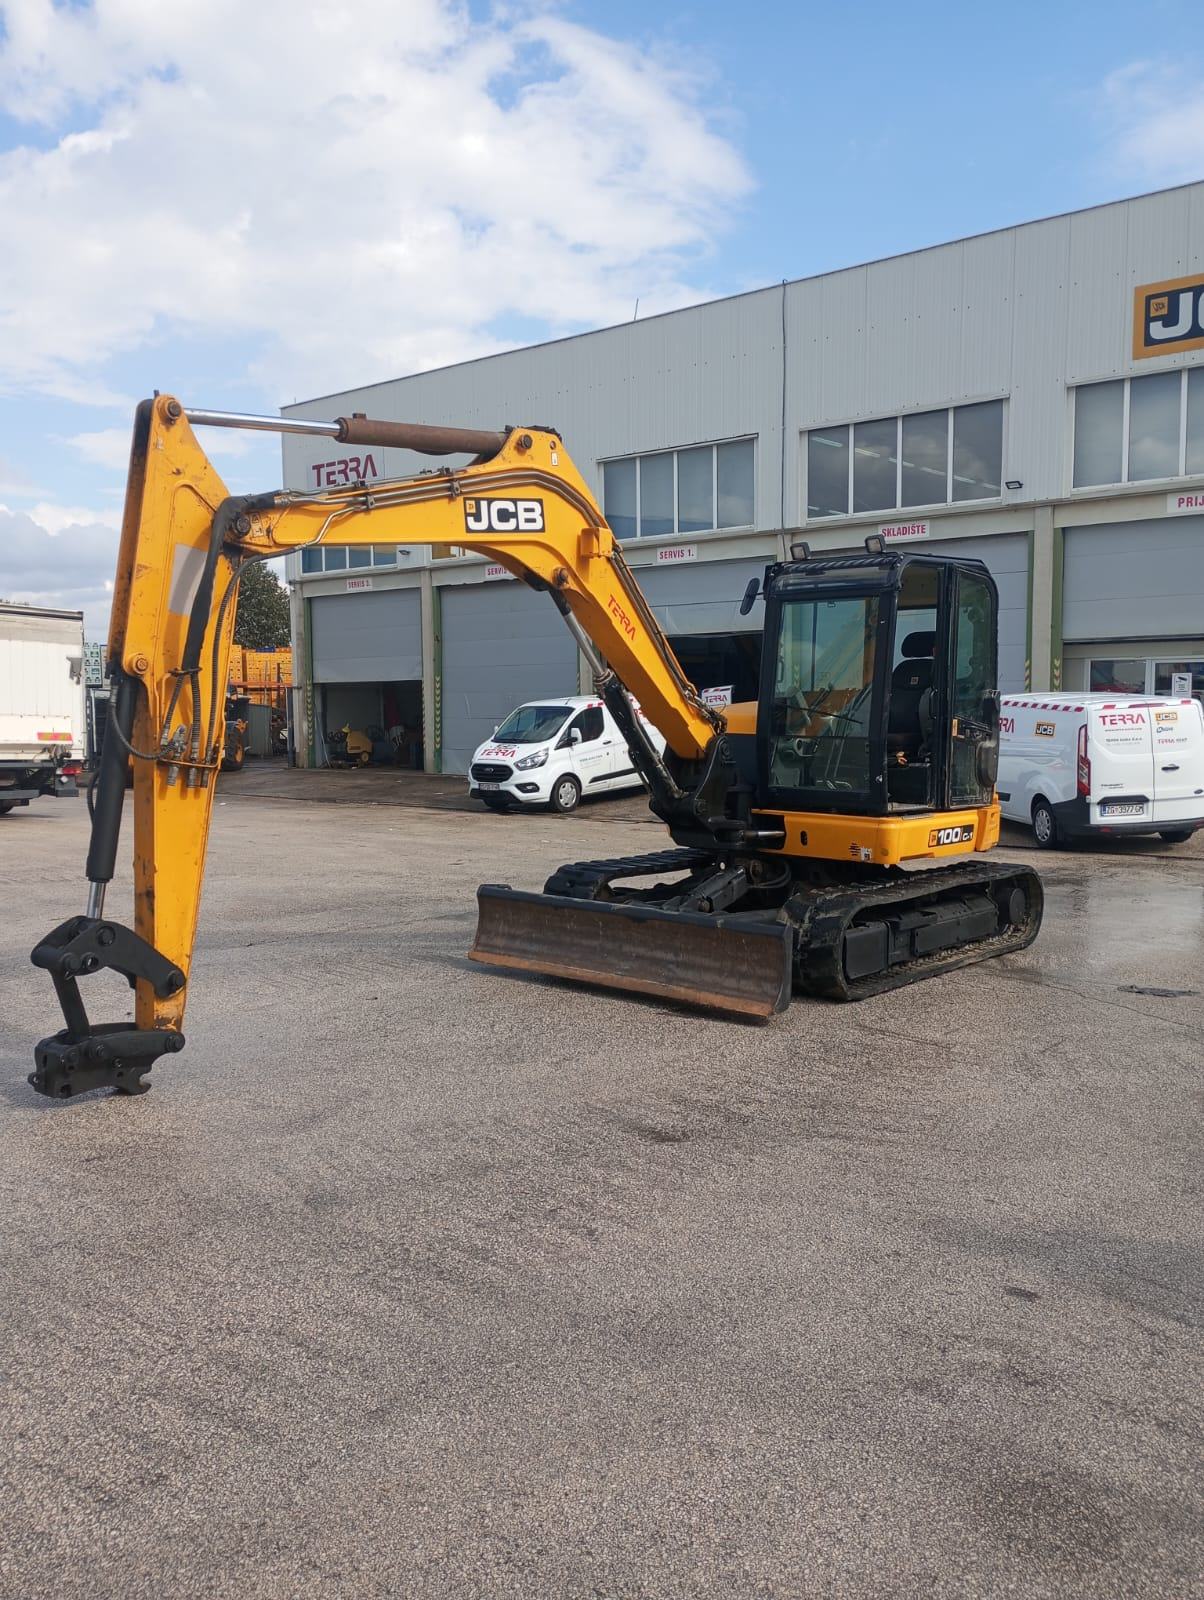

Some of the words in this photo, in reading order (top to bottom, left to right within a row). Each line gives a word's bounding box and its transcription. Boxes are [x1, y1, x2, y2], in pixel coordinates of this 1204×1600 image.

[1149, 291, 1204, 340] J
[312, 454, 377, 487] TERRA
[466, 500, 543, 531] JCB
[881, 522, 926, 538] SKLADIŠTE
[659, 549, 685, 560] SERVIS
[687, 548, 695, 557] 1.
[608, 594, 635, 640] TERRA
[705, 694, 728, 703] TERRA
[1098, 713, 1145, 726] TERRA
[1155, 712, 1178, 722] JCB
[1036, 723, 1054, 736] JCB
[480, 748, 516, 757] TERRA
[938, 828, 960, 844] 100
